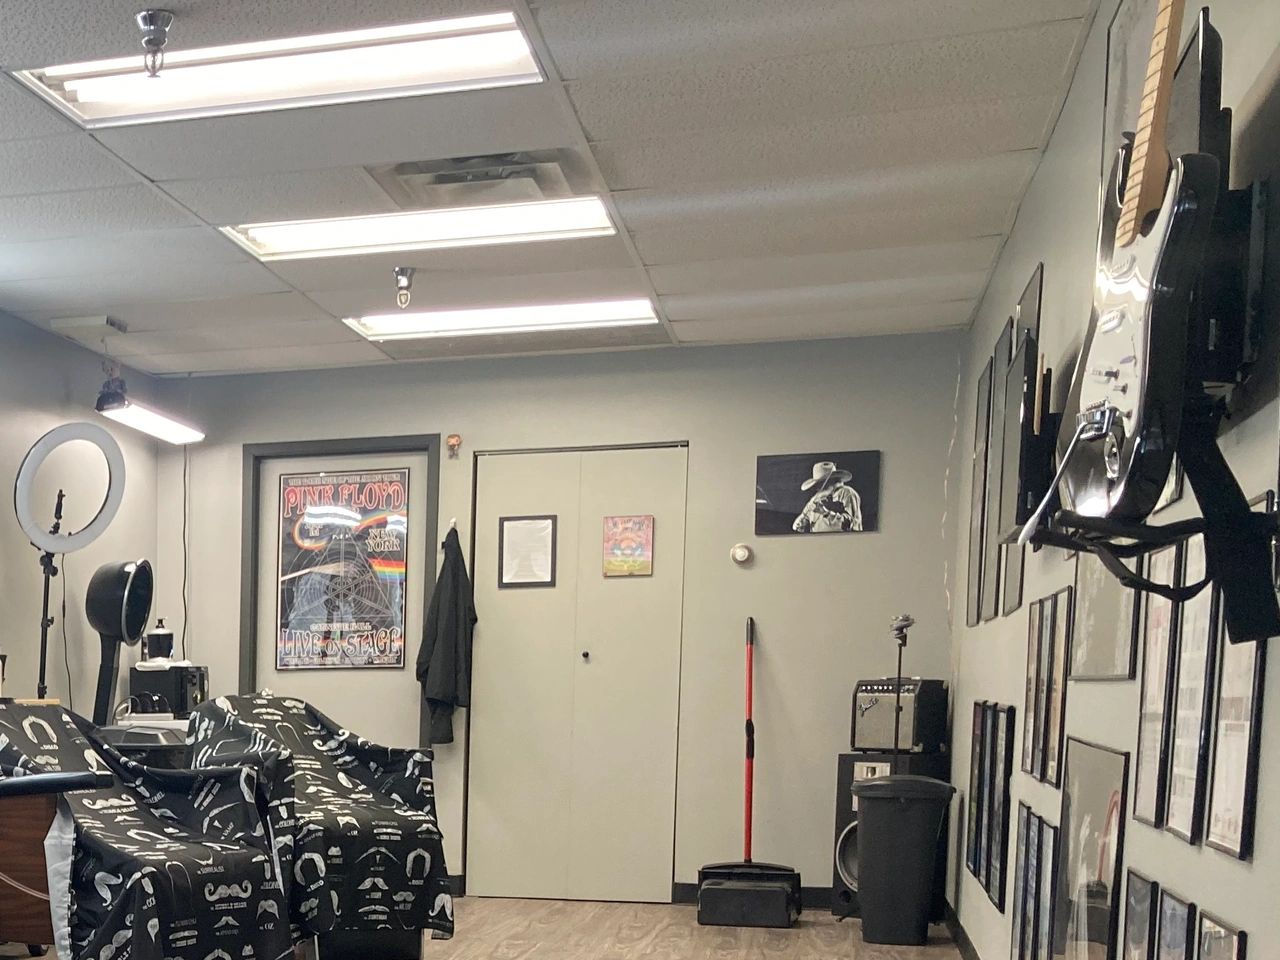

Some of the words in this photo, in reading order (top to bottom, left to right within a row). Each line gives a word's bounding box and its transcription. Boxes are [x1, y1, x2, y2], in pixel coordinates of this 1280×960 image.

[283, 484, 335, 518] PINK
[338, 481, 405, 512] FLOYD
[366, 539, 401, 552] YORK
[282, 628, 320, 658] LIVE
[345, 626, 402, 657] STAGE
